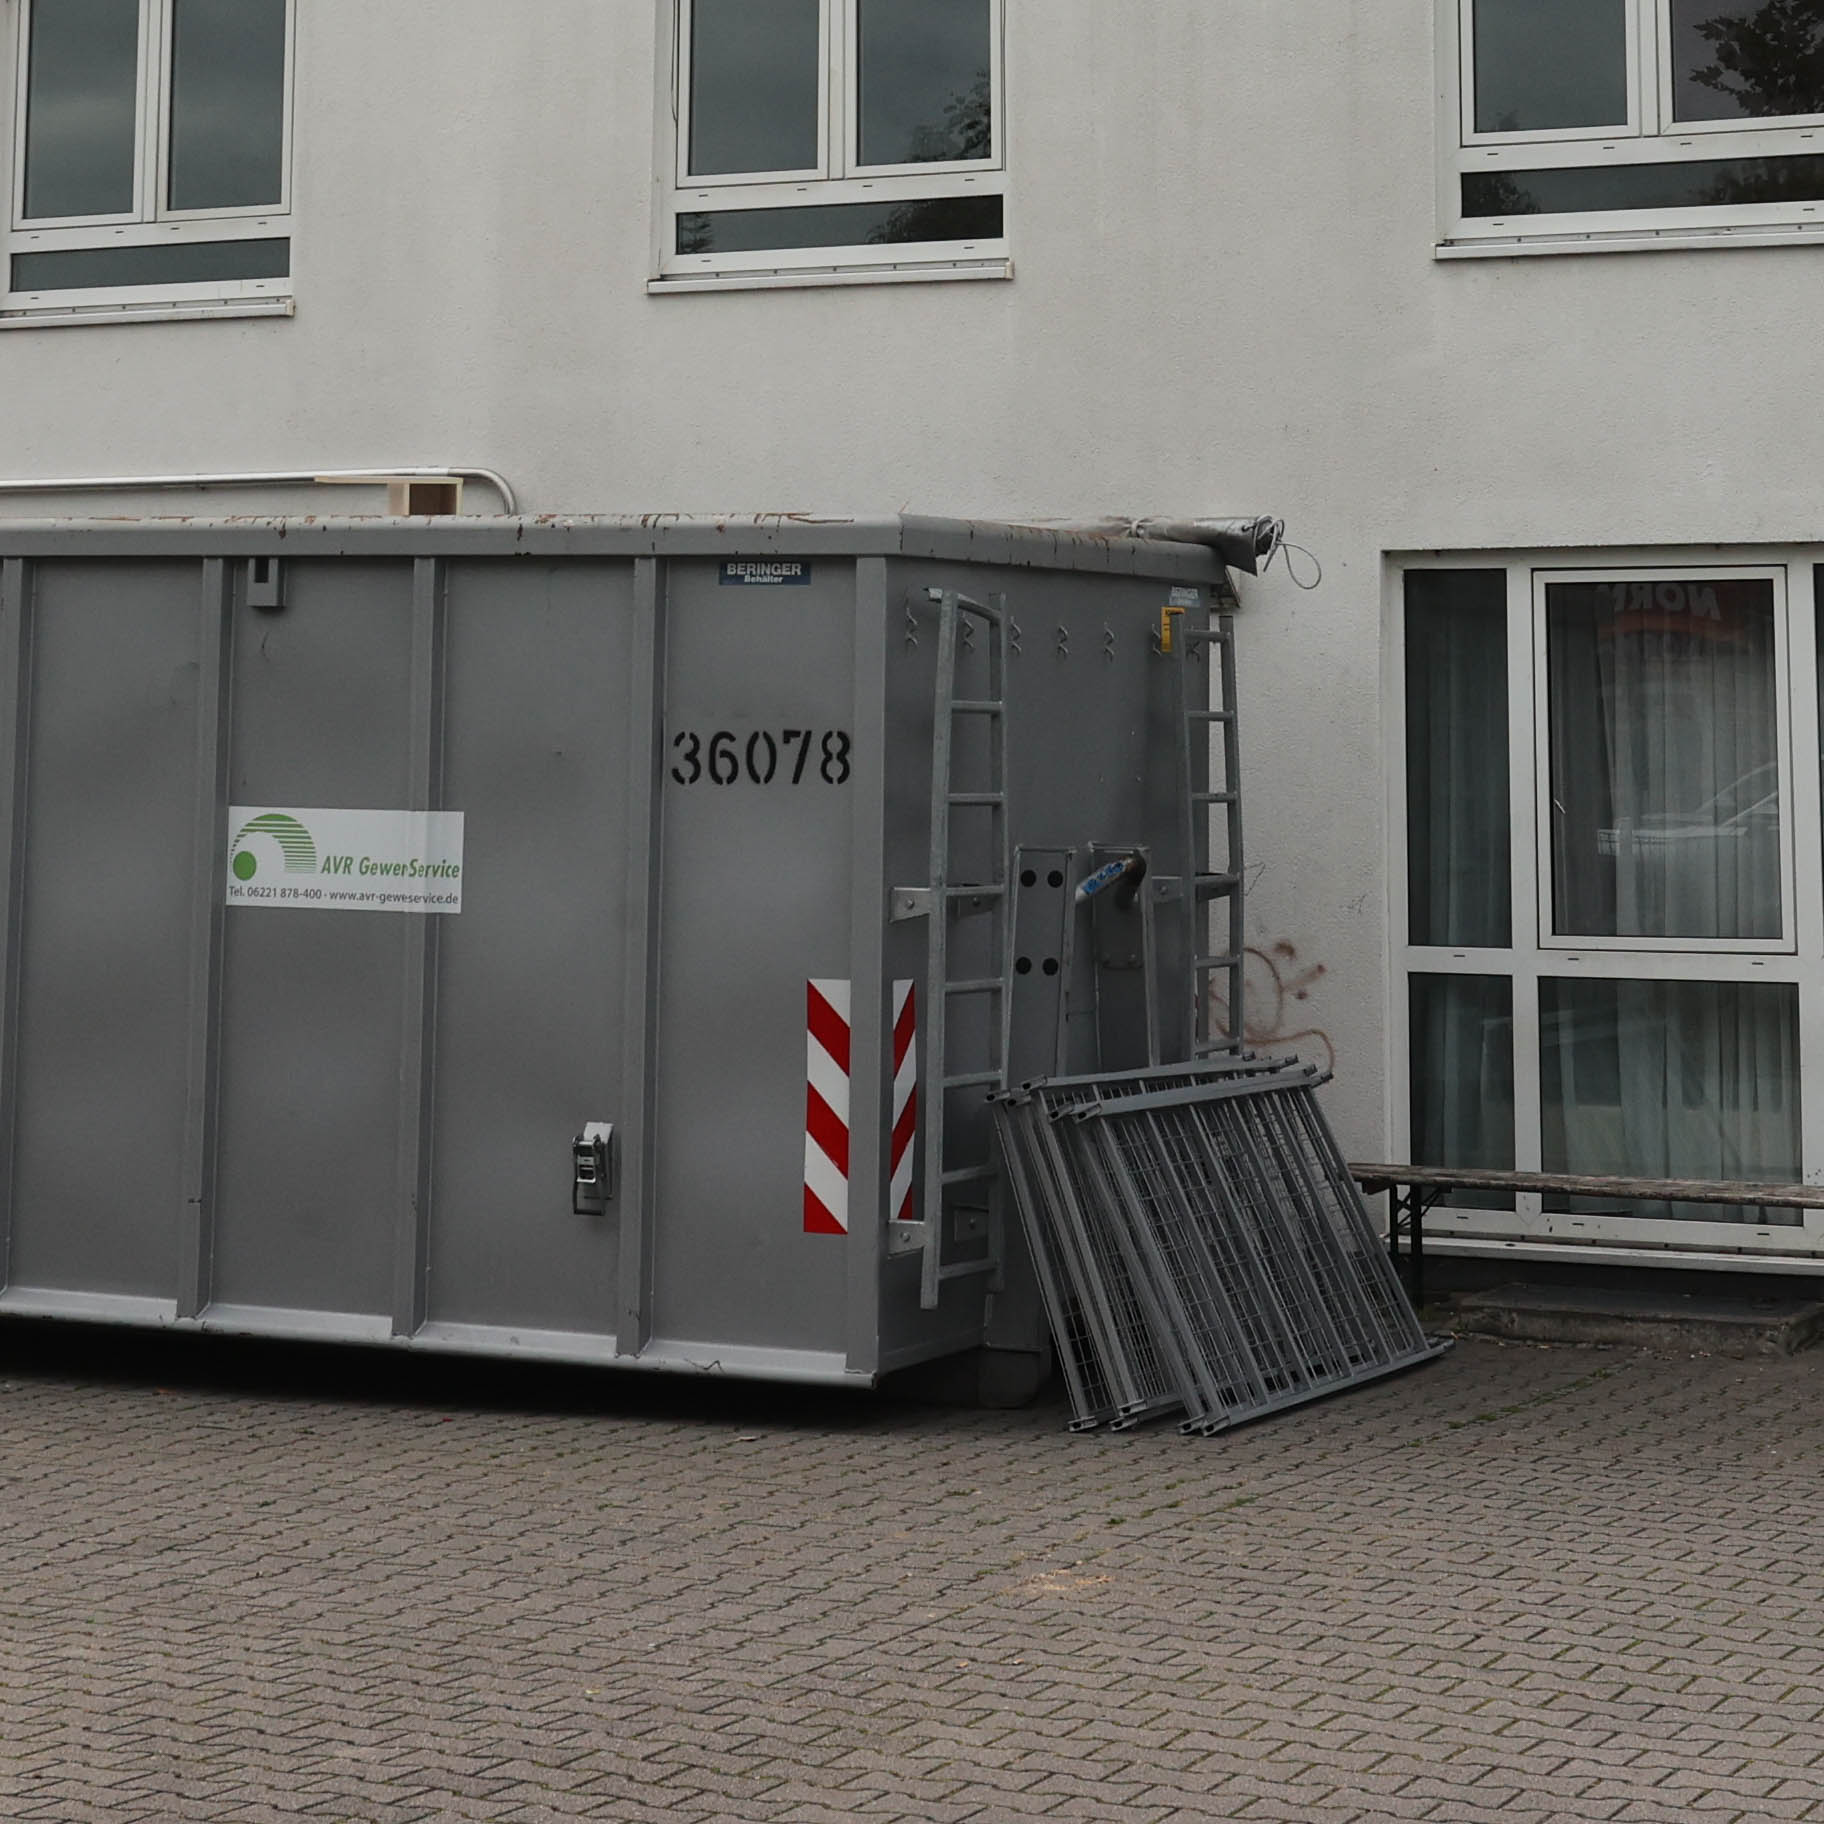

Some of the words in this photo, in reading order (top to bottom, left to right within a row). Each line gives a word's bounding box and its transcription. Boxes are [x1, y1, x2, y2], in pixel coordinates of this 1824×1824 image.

[727, 562, 802, 576] BERINGER
[670, 729, 851, 785] 36078
[321, 855, 353, 875] AVR
[229, 886, 245, 898] Tel.
[247, 887, 277, 899] 06221
[280, 888, 322, 900] 878-400
